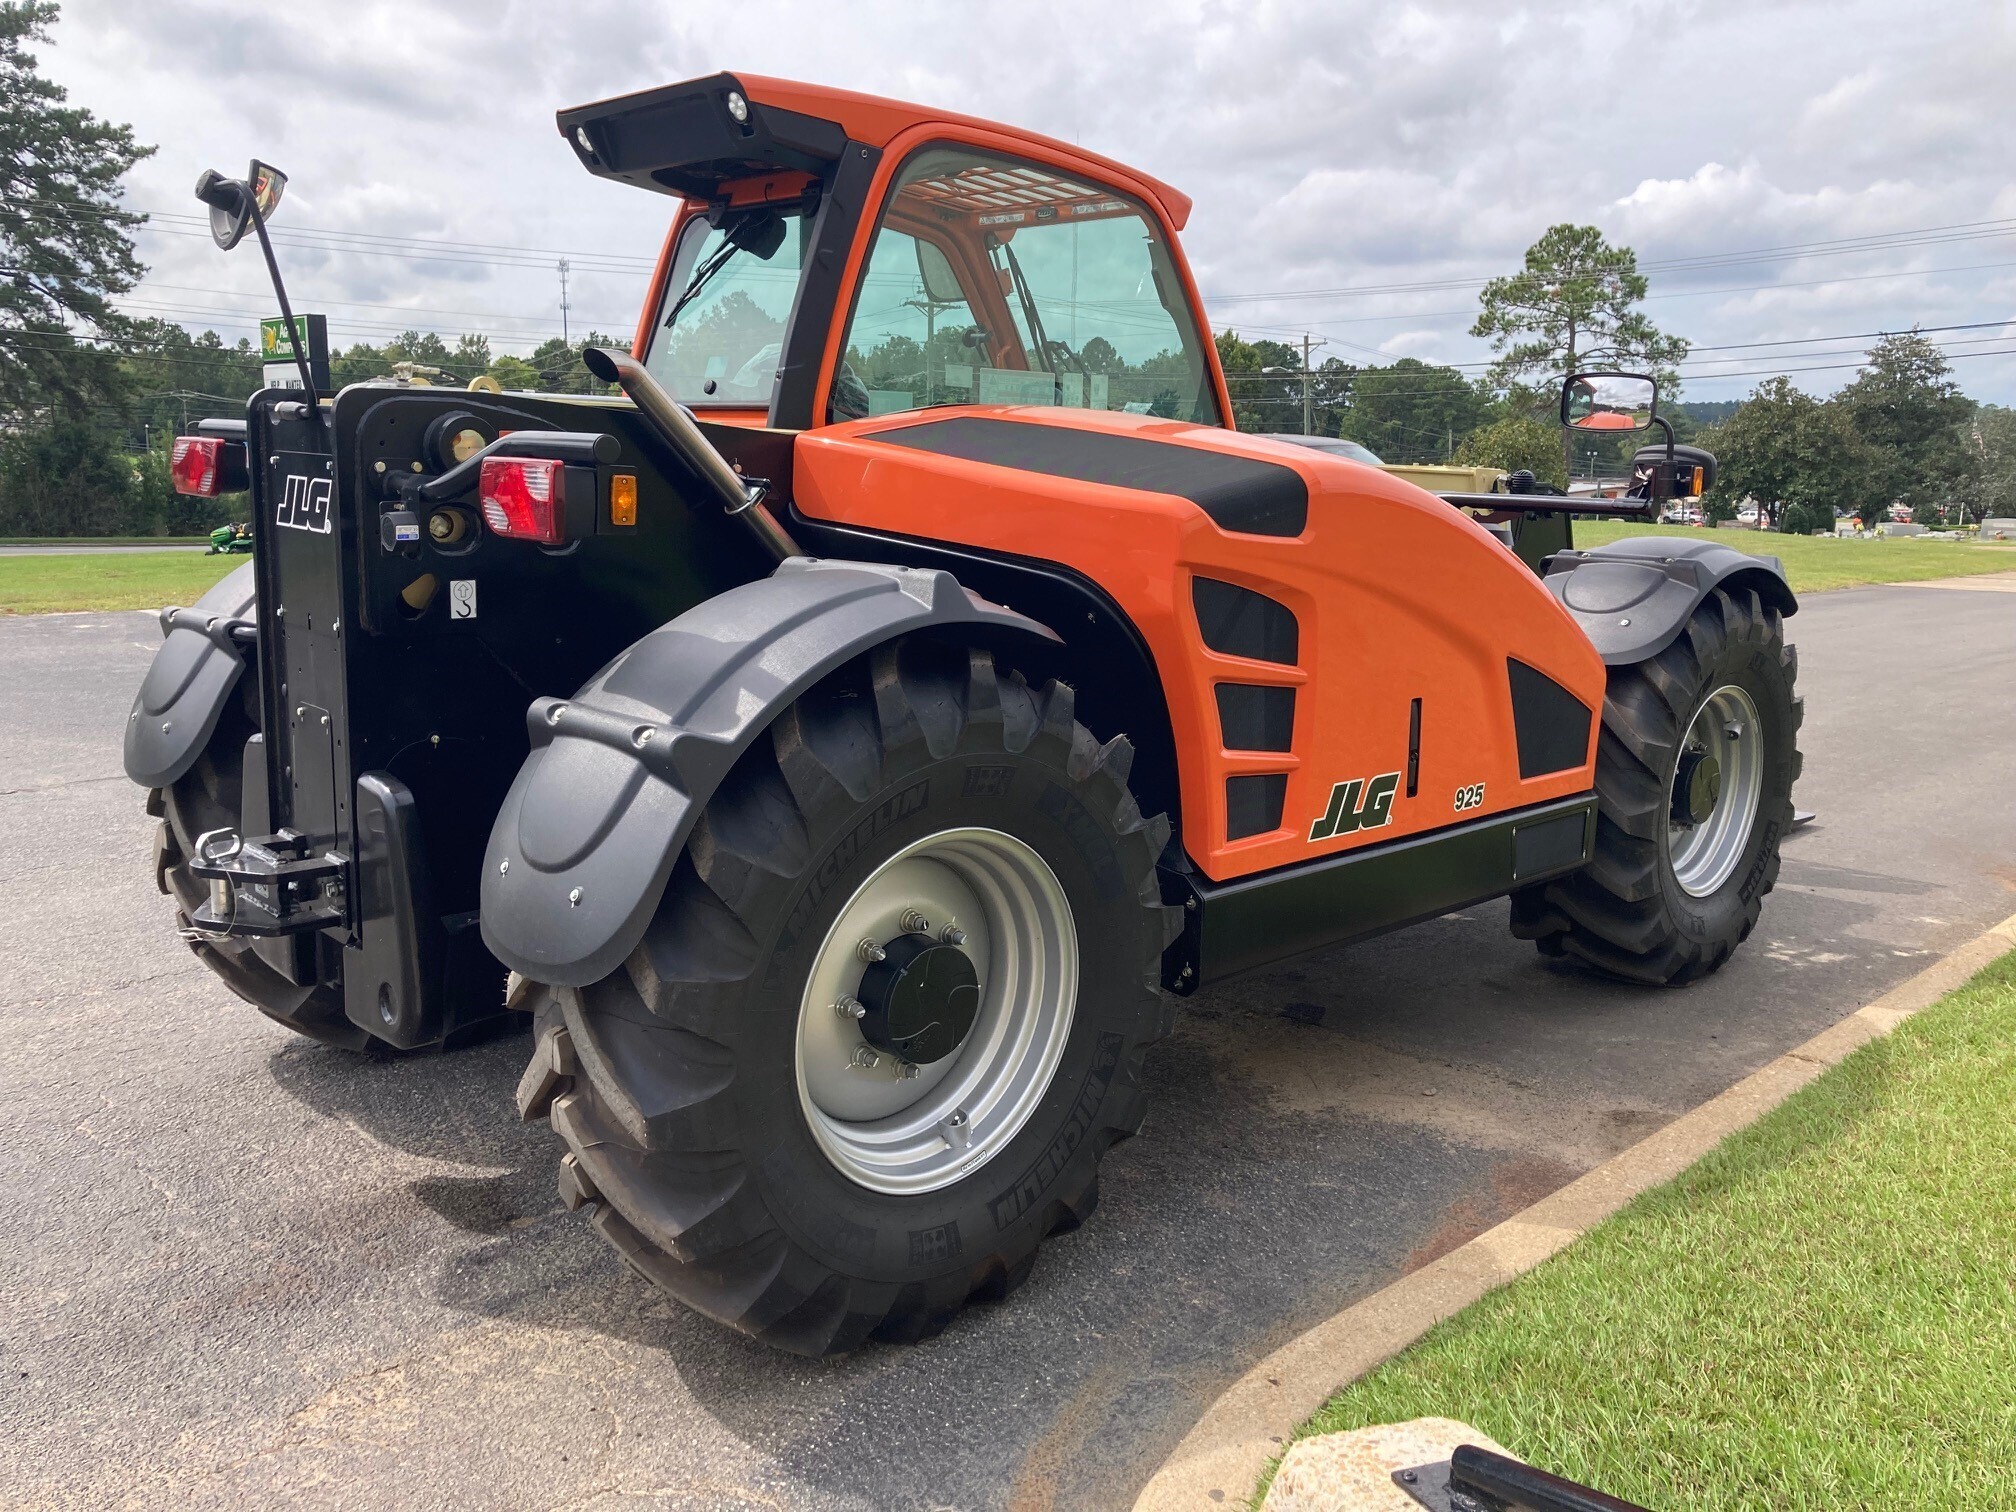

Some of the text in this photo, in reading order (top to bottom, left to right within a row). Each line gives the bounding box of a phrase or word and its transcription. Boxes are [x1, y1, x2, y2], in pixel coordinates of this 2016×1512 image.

[276, 474, 332, 534] JLG
[1307, 771, 1402, 843] JLG
[1453, 782, 1486, 812] 925
[996, 1073, 1108, 1231] MICHELIN
